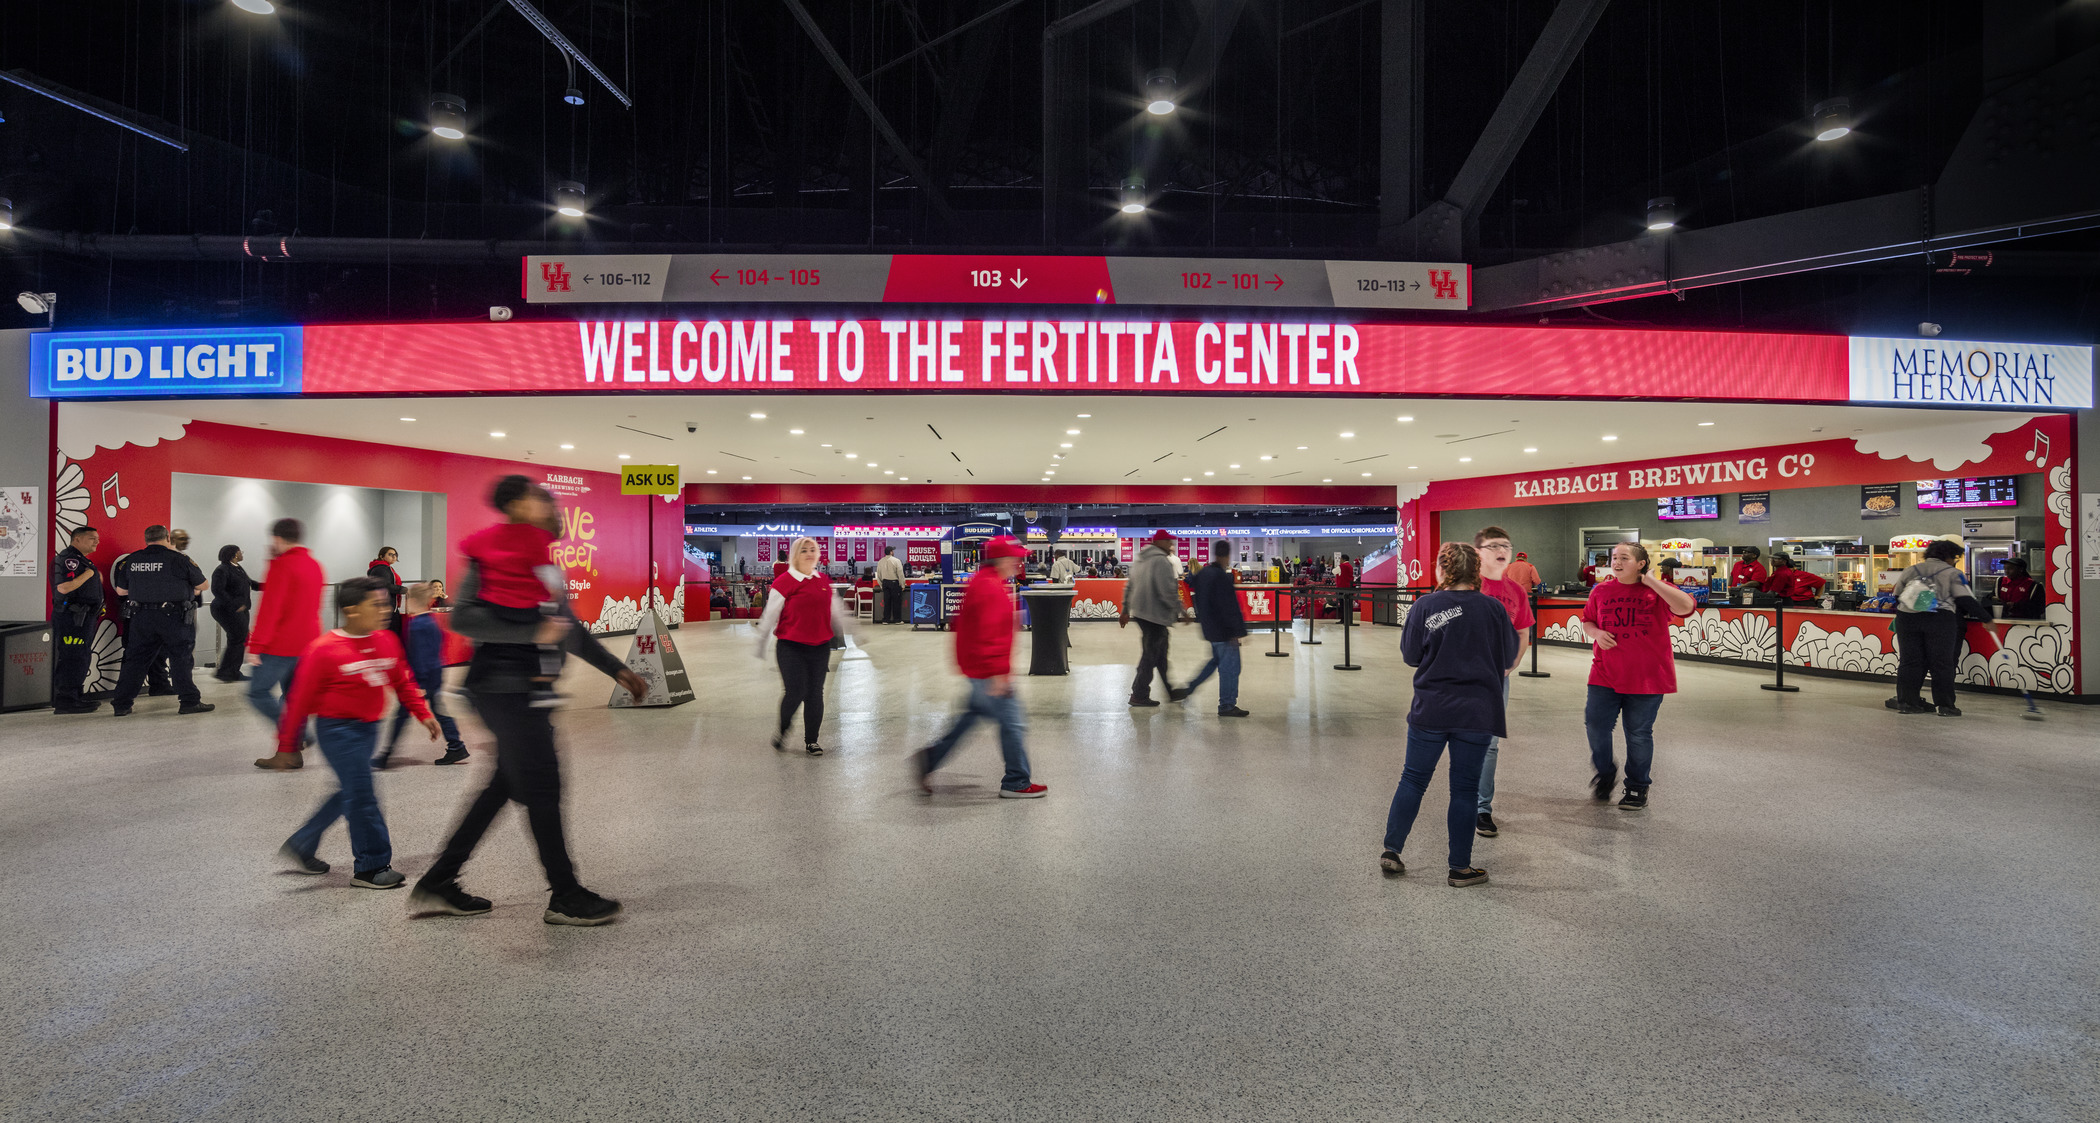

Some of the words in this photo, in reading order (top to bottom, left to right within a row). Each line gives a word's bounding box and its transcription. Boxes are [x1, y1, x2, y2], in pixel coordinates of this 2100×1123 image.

[737, 270, 769, 286] 104
[789, 270, 820, 286] 105
[971, 270, 1001, 287] 103
[1182, 272, 1212, 289] 102
[1232, 273, 1259, 290] 101
[579, 321, 793, 382] WELCOME
[811, 320, 864, 383] TO
[881, 320, 964, 382] THE
[981, 321, 1180, 383] FERTITTA
[1195, 322, 1360, 386] CENTER
[57, 346, 143, 381] BUD
[1893, 348, 2055, 379] MEMORIAL
[1893, 373, 2054, 404] HERMANN
[547, 473, 583, 485] KARBACH
[626, 474, 652, 486] ASK
[657, 474, 675, 486] US
[1514, 472, 1618, 498] KARBACH
[1628, 458, 1768, 489] BREWING
[1677, 541, 1692, 549] CORN
[1891, 539, 1907, 548] POP
[1916, 539, 1933, 548] COR
[130, 562, 163, 572] SHERIFF
[570, 579, 591, 591] Style
